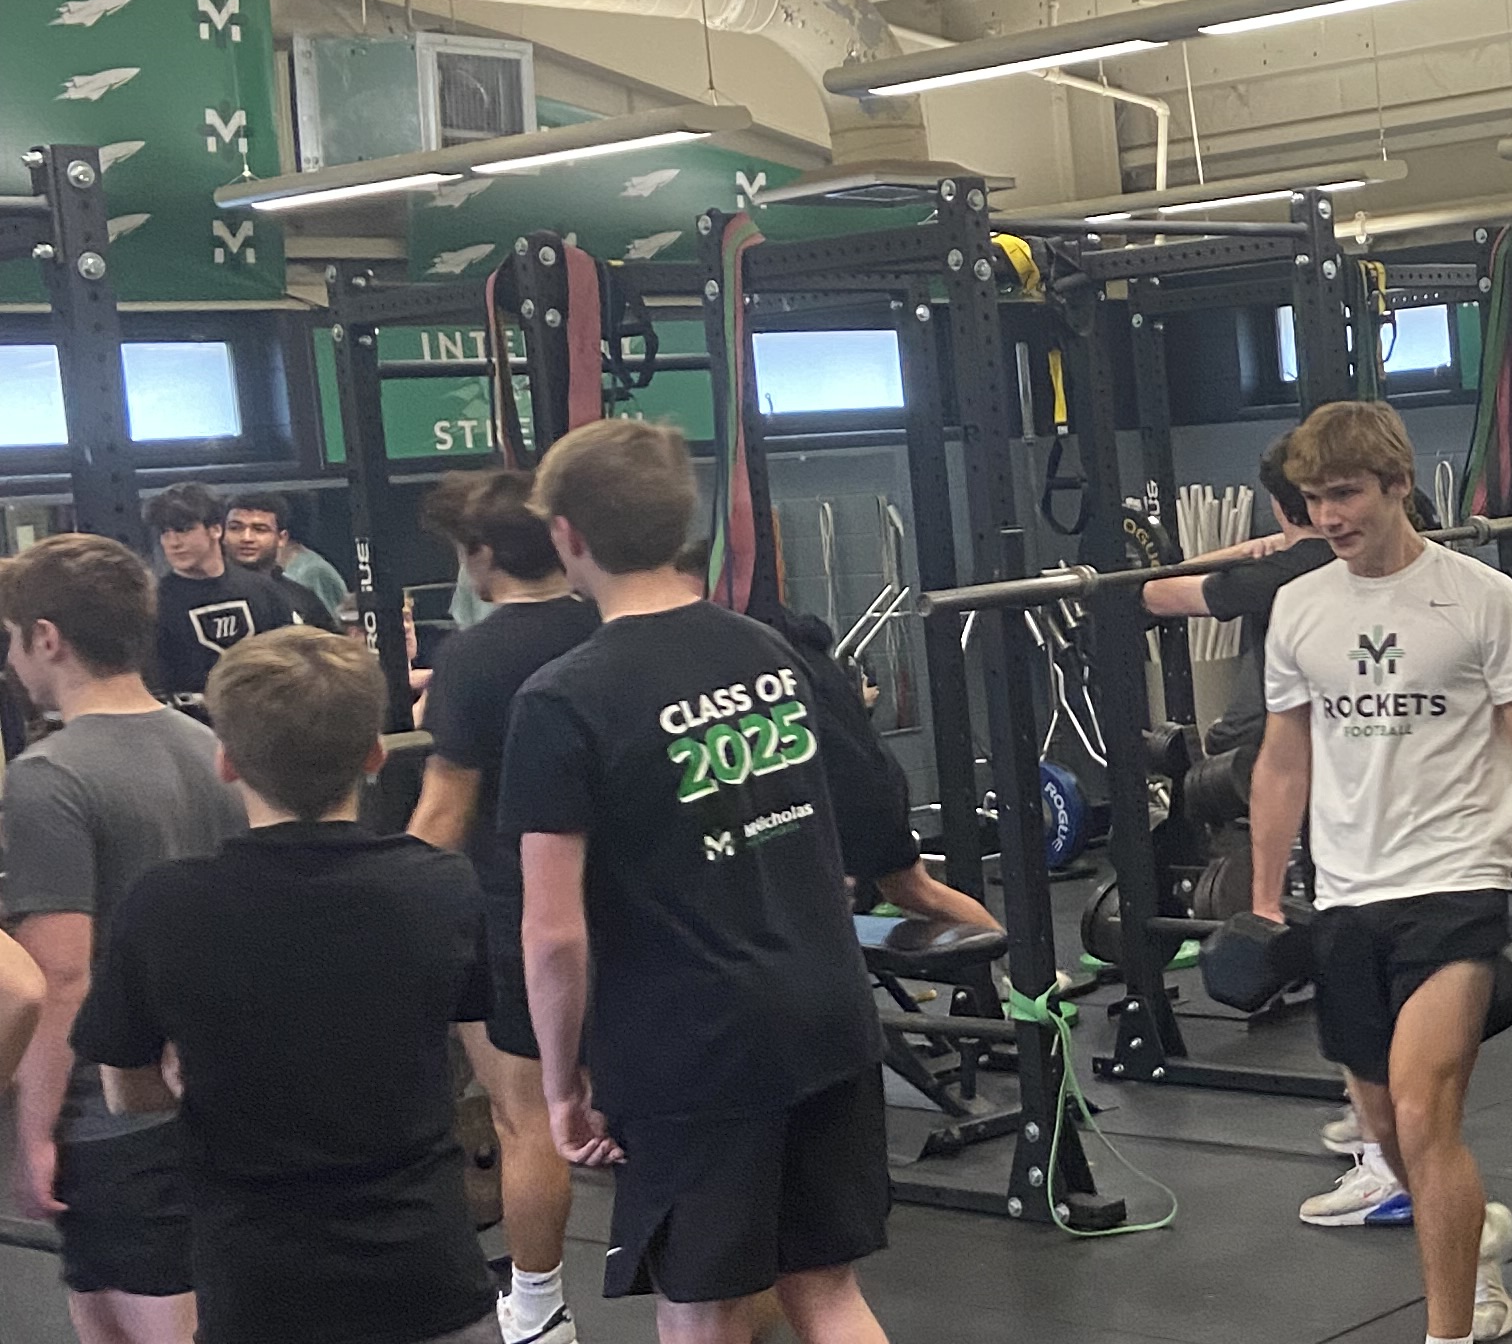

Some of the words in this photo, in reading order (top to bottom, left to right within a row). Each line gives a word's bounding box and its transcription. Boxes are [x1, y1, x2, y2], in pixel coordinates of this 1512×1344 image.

[659, 683, 753, 735] CLASS
[755, 668, 798, 702] OF
[1323, 693, 1447, 720] ROCKETS
[667, 700, 818, 804] 2025
[1044, 781, 1069, 852] ROGUE
